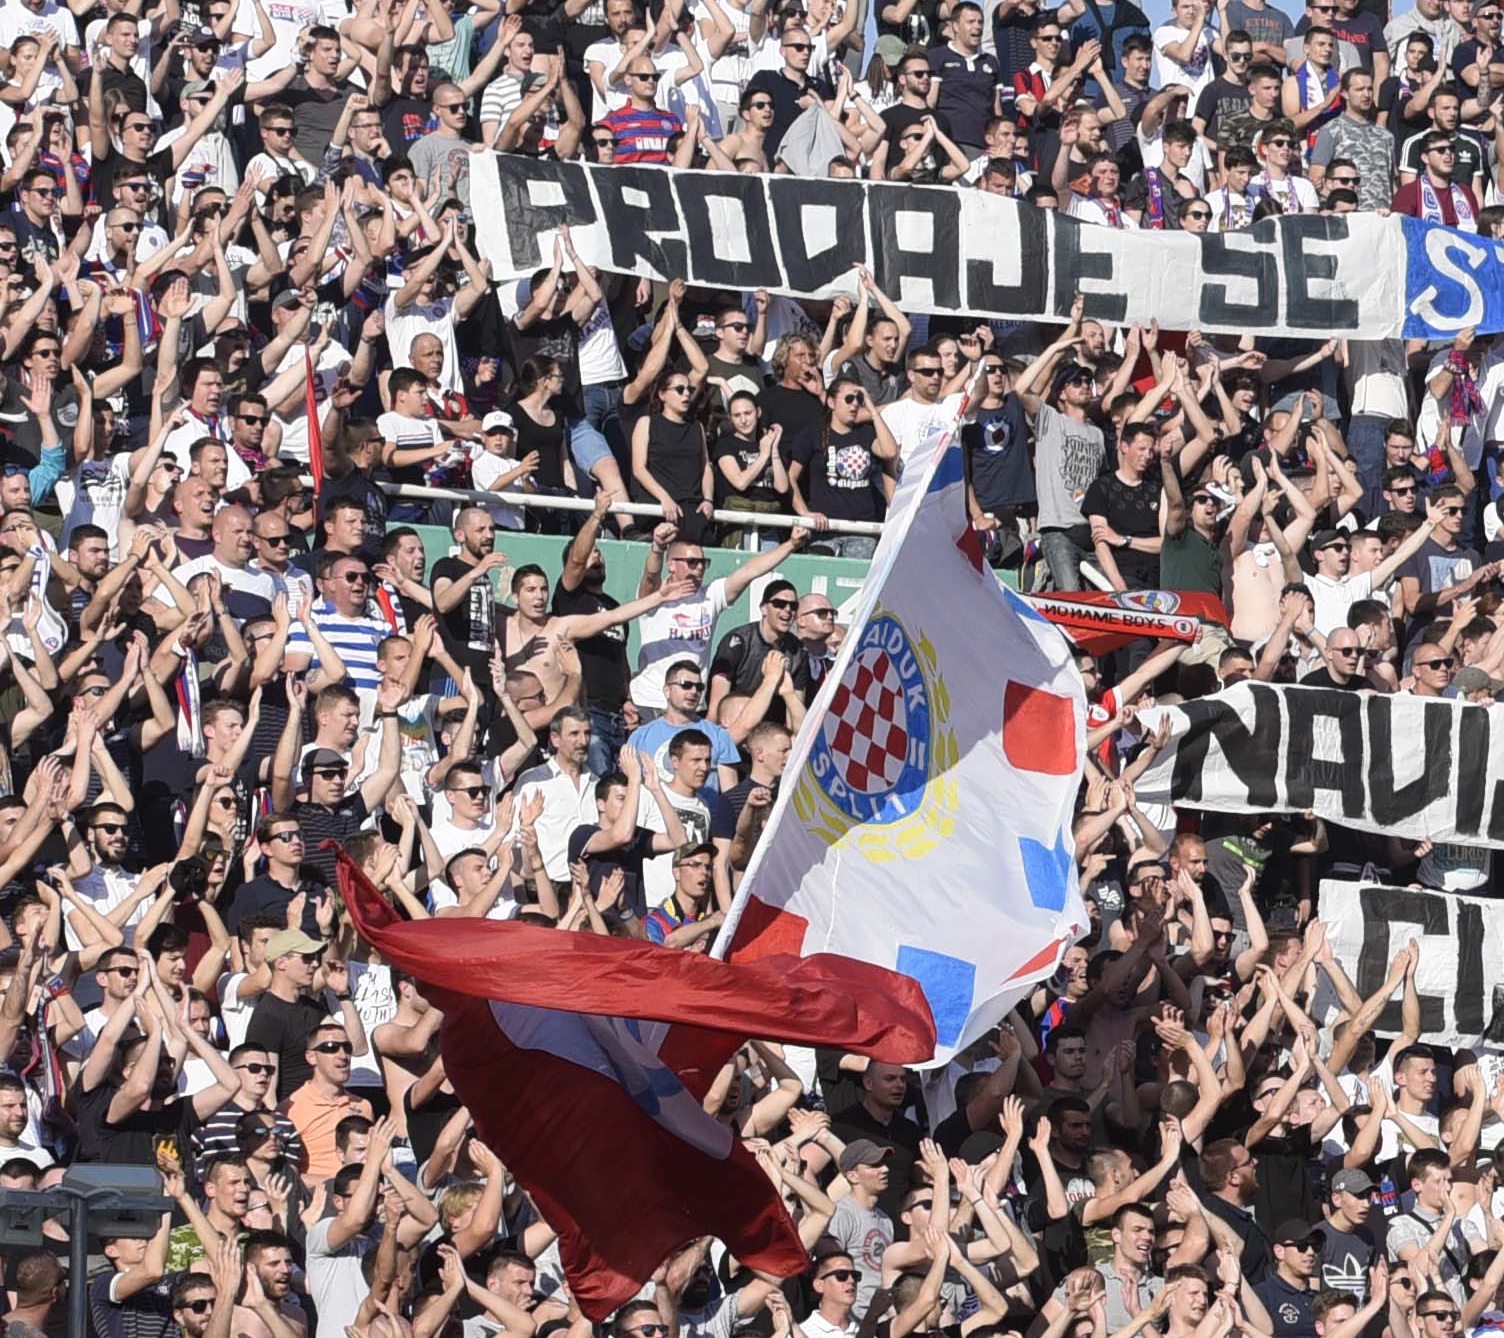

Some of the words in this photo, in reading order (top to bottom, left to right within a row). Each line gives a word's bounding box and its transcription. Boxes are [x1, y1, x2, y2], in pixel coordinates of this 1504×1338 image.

[500, 156, 1128, 321] PRODAJE
[1201, 213, 1360, 331] SE
[864, 620, 927, 709] AJDUK
